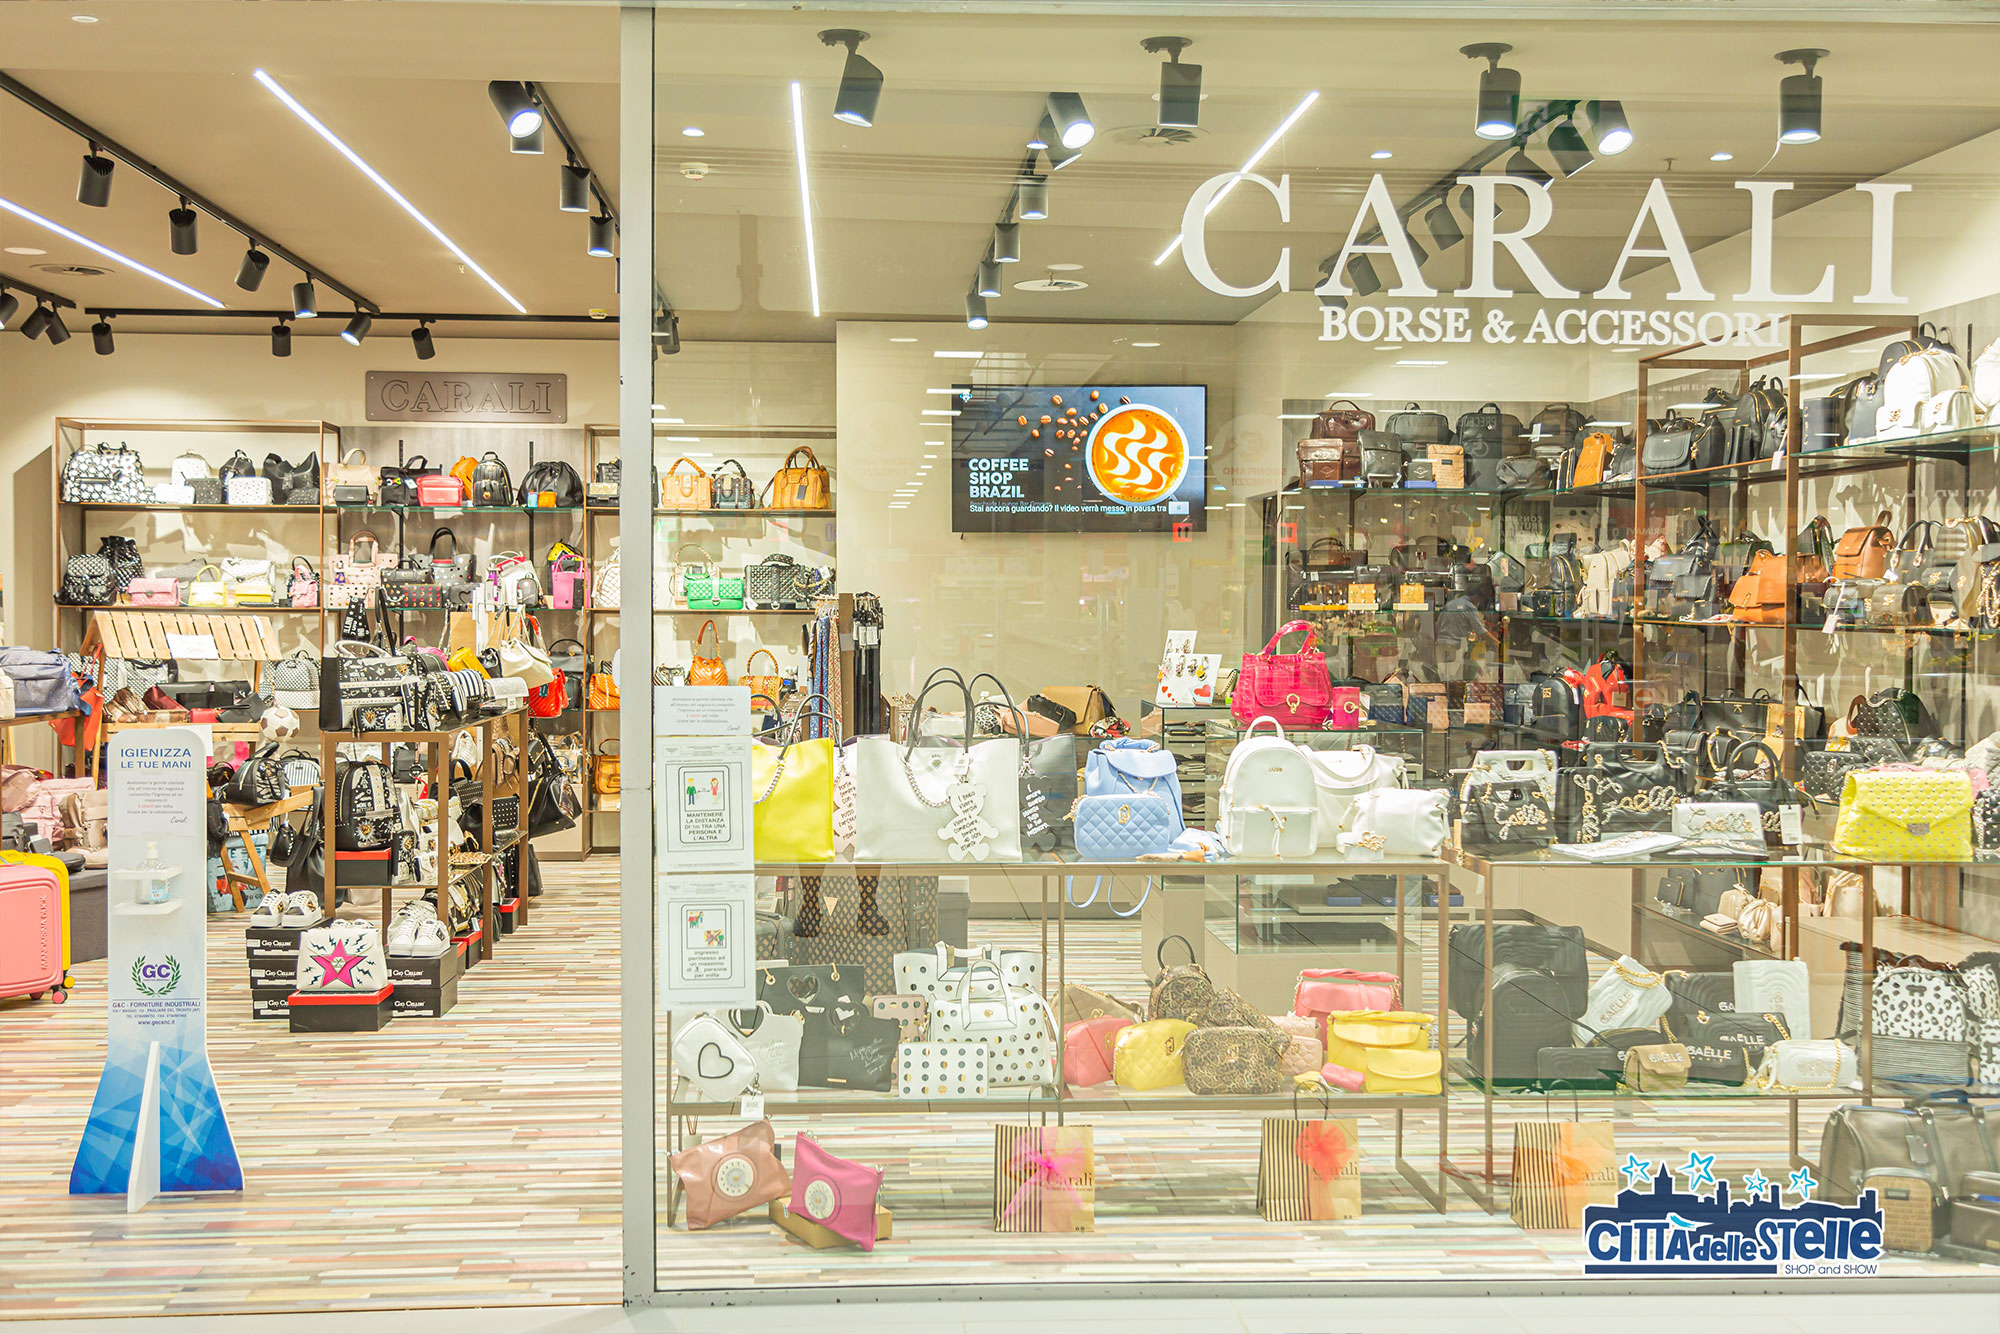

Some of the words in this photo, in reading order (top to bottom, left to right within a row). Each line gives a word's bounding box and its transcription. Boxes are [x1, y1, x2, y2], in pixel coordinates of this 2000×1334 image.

[1182, 173, 1913, 305] CARALI
[1319, 305, 1472, 344] BORSE
[1482, 307, 1516, 344] &
[1524, 307, 1784, 348] ACCESSORI
[381, 379, 552, 415] CARALI
[968, 458, 1029, 472] COFFEE
[969, 472, 1013, 485] SHOP
[969, 485, 1025, 498] BRAZIL
[969, 504, 983, 512] Stai
[1011, 504, 1053, 514] guardando?
[1060, 504, 1080, 512] video
[1081, 504, 1099, 513] verrà
[1100, 505, 1125, 513] messo
[1126, 504, 1133, 513] in
[1134, 506, 1156, 515] pausa
[1157, 505, 1167, 513] tra
[120, 748, 192, 758] IGIENIZZA
[120, 761, 134, 769] LE
[137, 761, 159, 769] TUE
[162, 761, 191, 769] MANI
